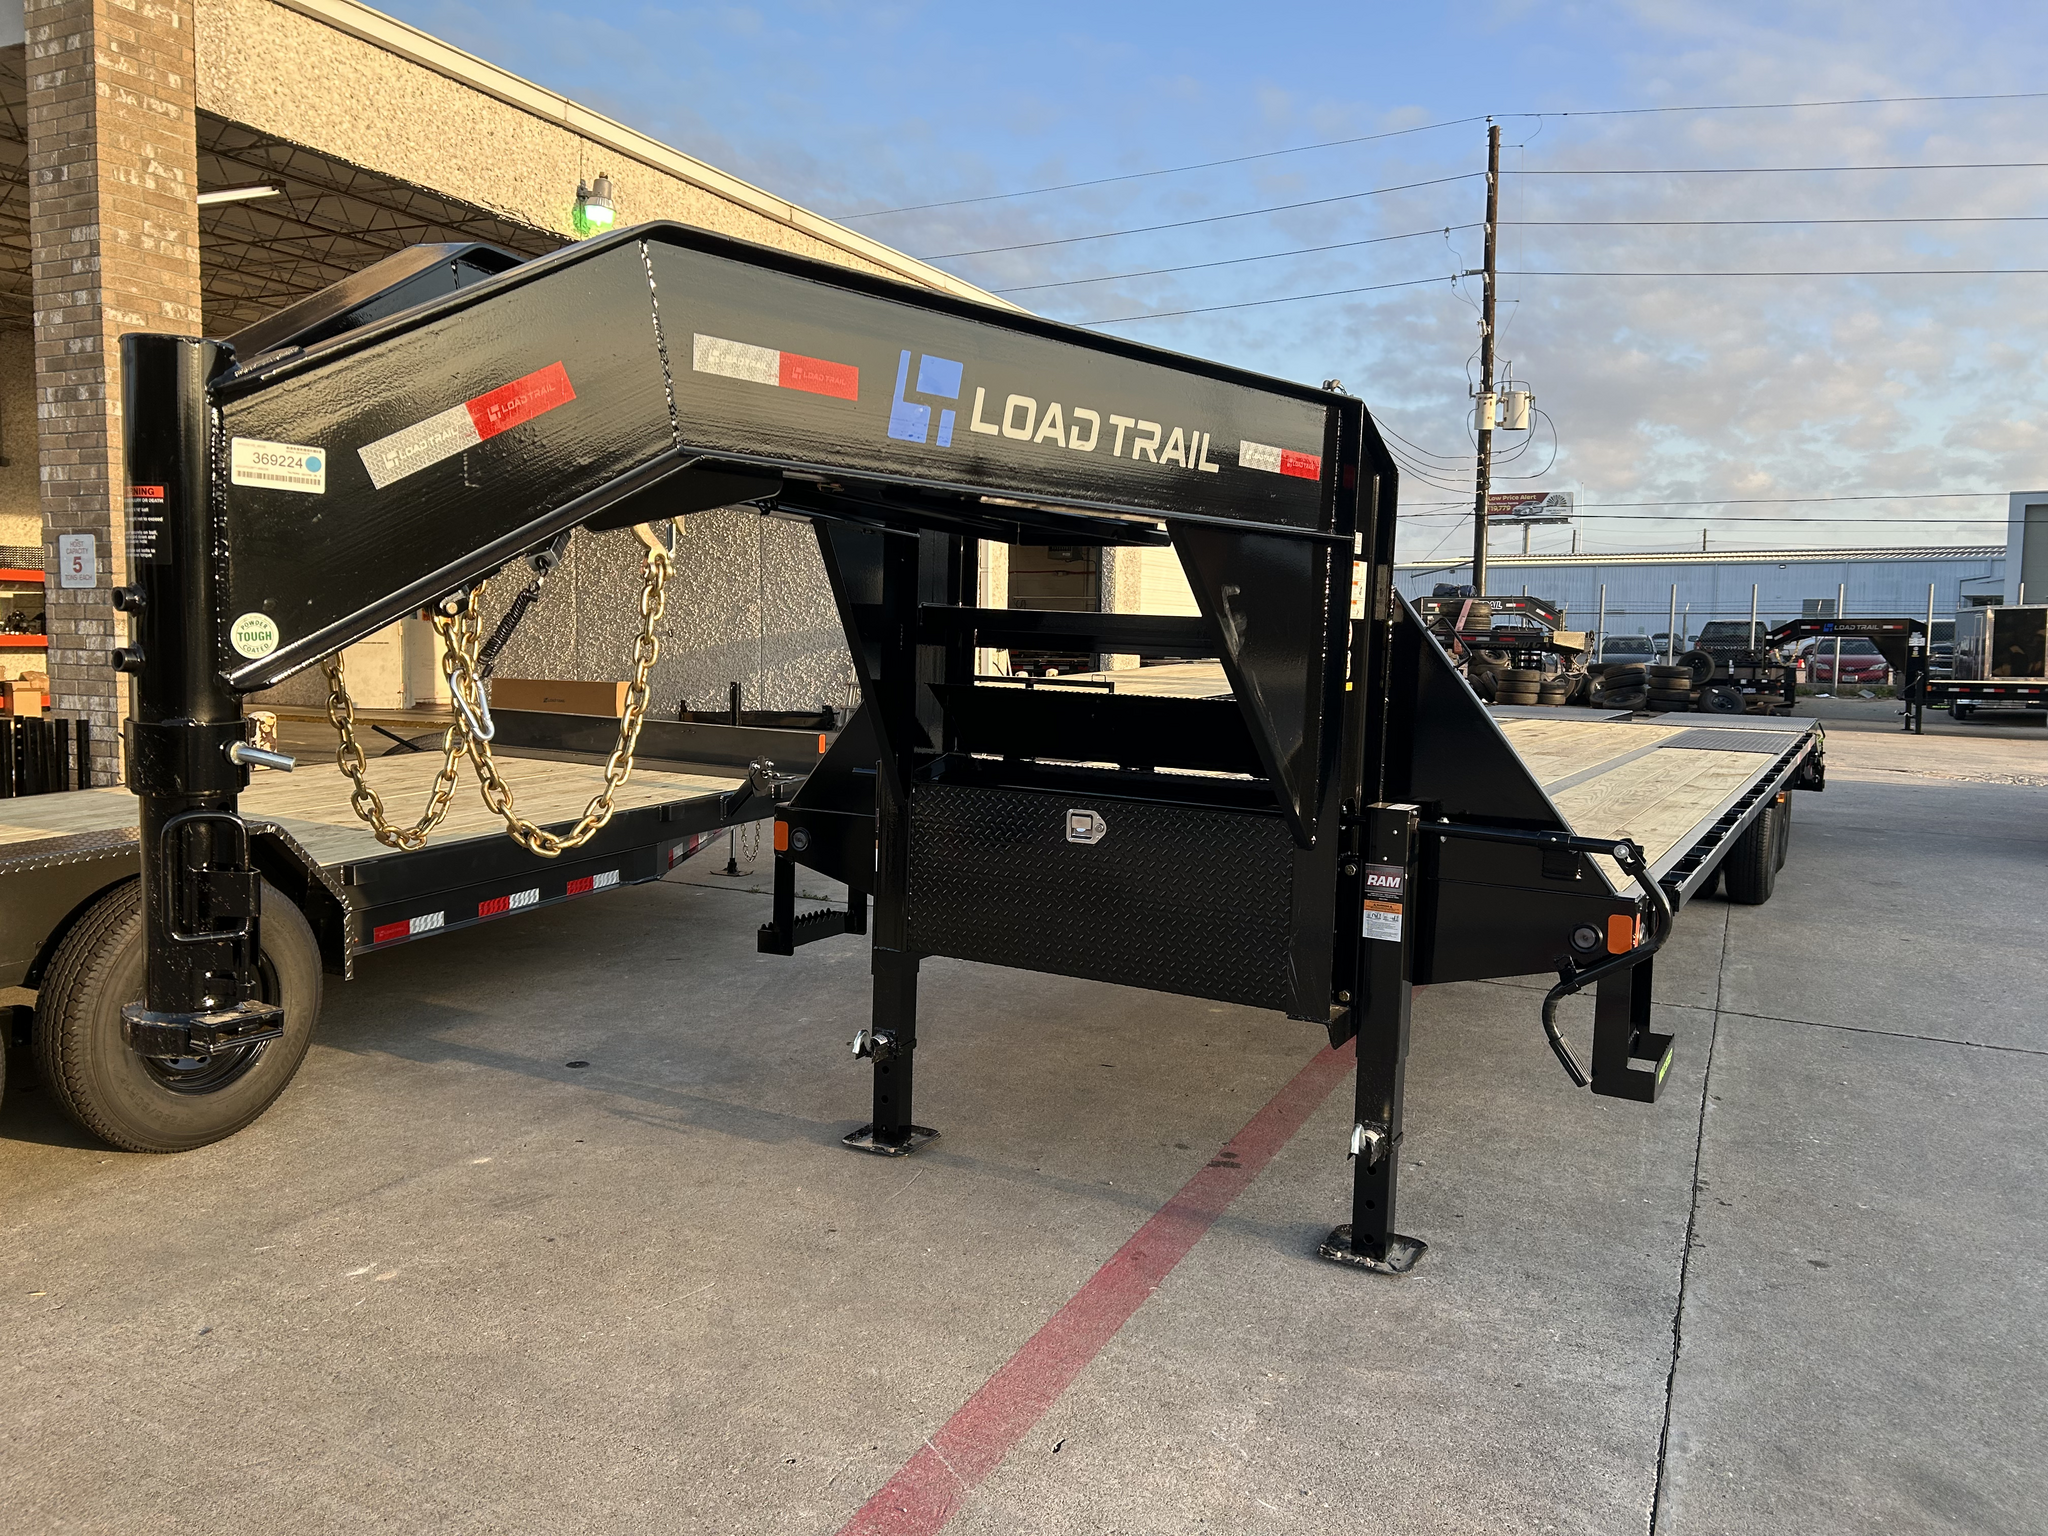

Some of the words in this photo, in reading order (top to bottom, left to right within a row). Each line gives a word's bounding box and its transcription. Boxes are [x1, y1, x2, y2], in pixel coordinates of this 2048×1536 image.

[803, 371, 824, 382] LOAD
[826, 375, 846, 386] TRAIL
[501, 395, 528, 413] LOAD
[528, 384, 556, 401] TRAIL
[969, 386, 1101, 452] LOAD
[1109, 413, 1220, 473] TRAIL
[399, 440, 427, 460] LOAD
[428, 427, 459, 446] TRAIL
[252, 451, 303, 469] 369224
[73, 556, 83, 573] 5
[240, 620, 268, 631] POWDER
[237, 631, 272, 642] TOUGH
[243, 643, 269, 653] COATED
[1367, 874, 1401, 888] RAM
